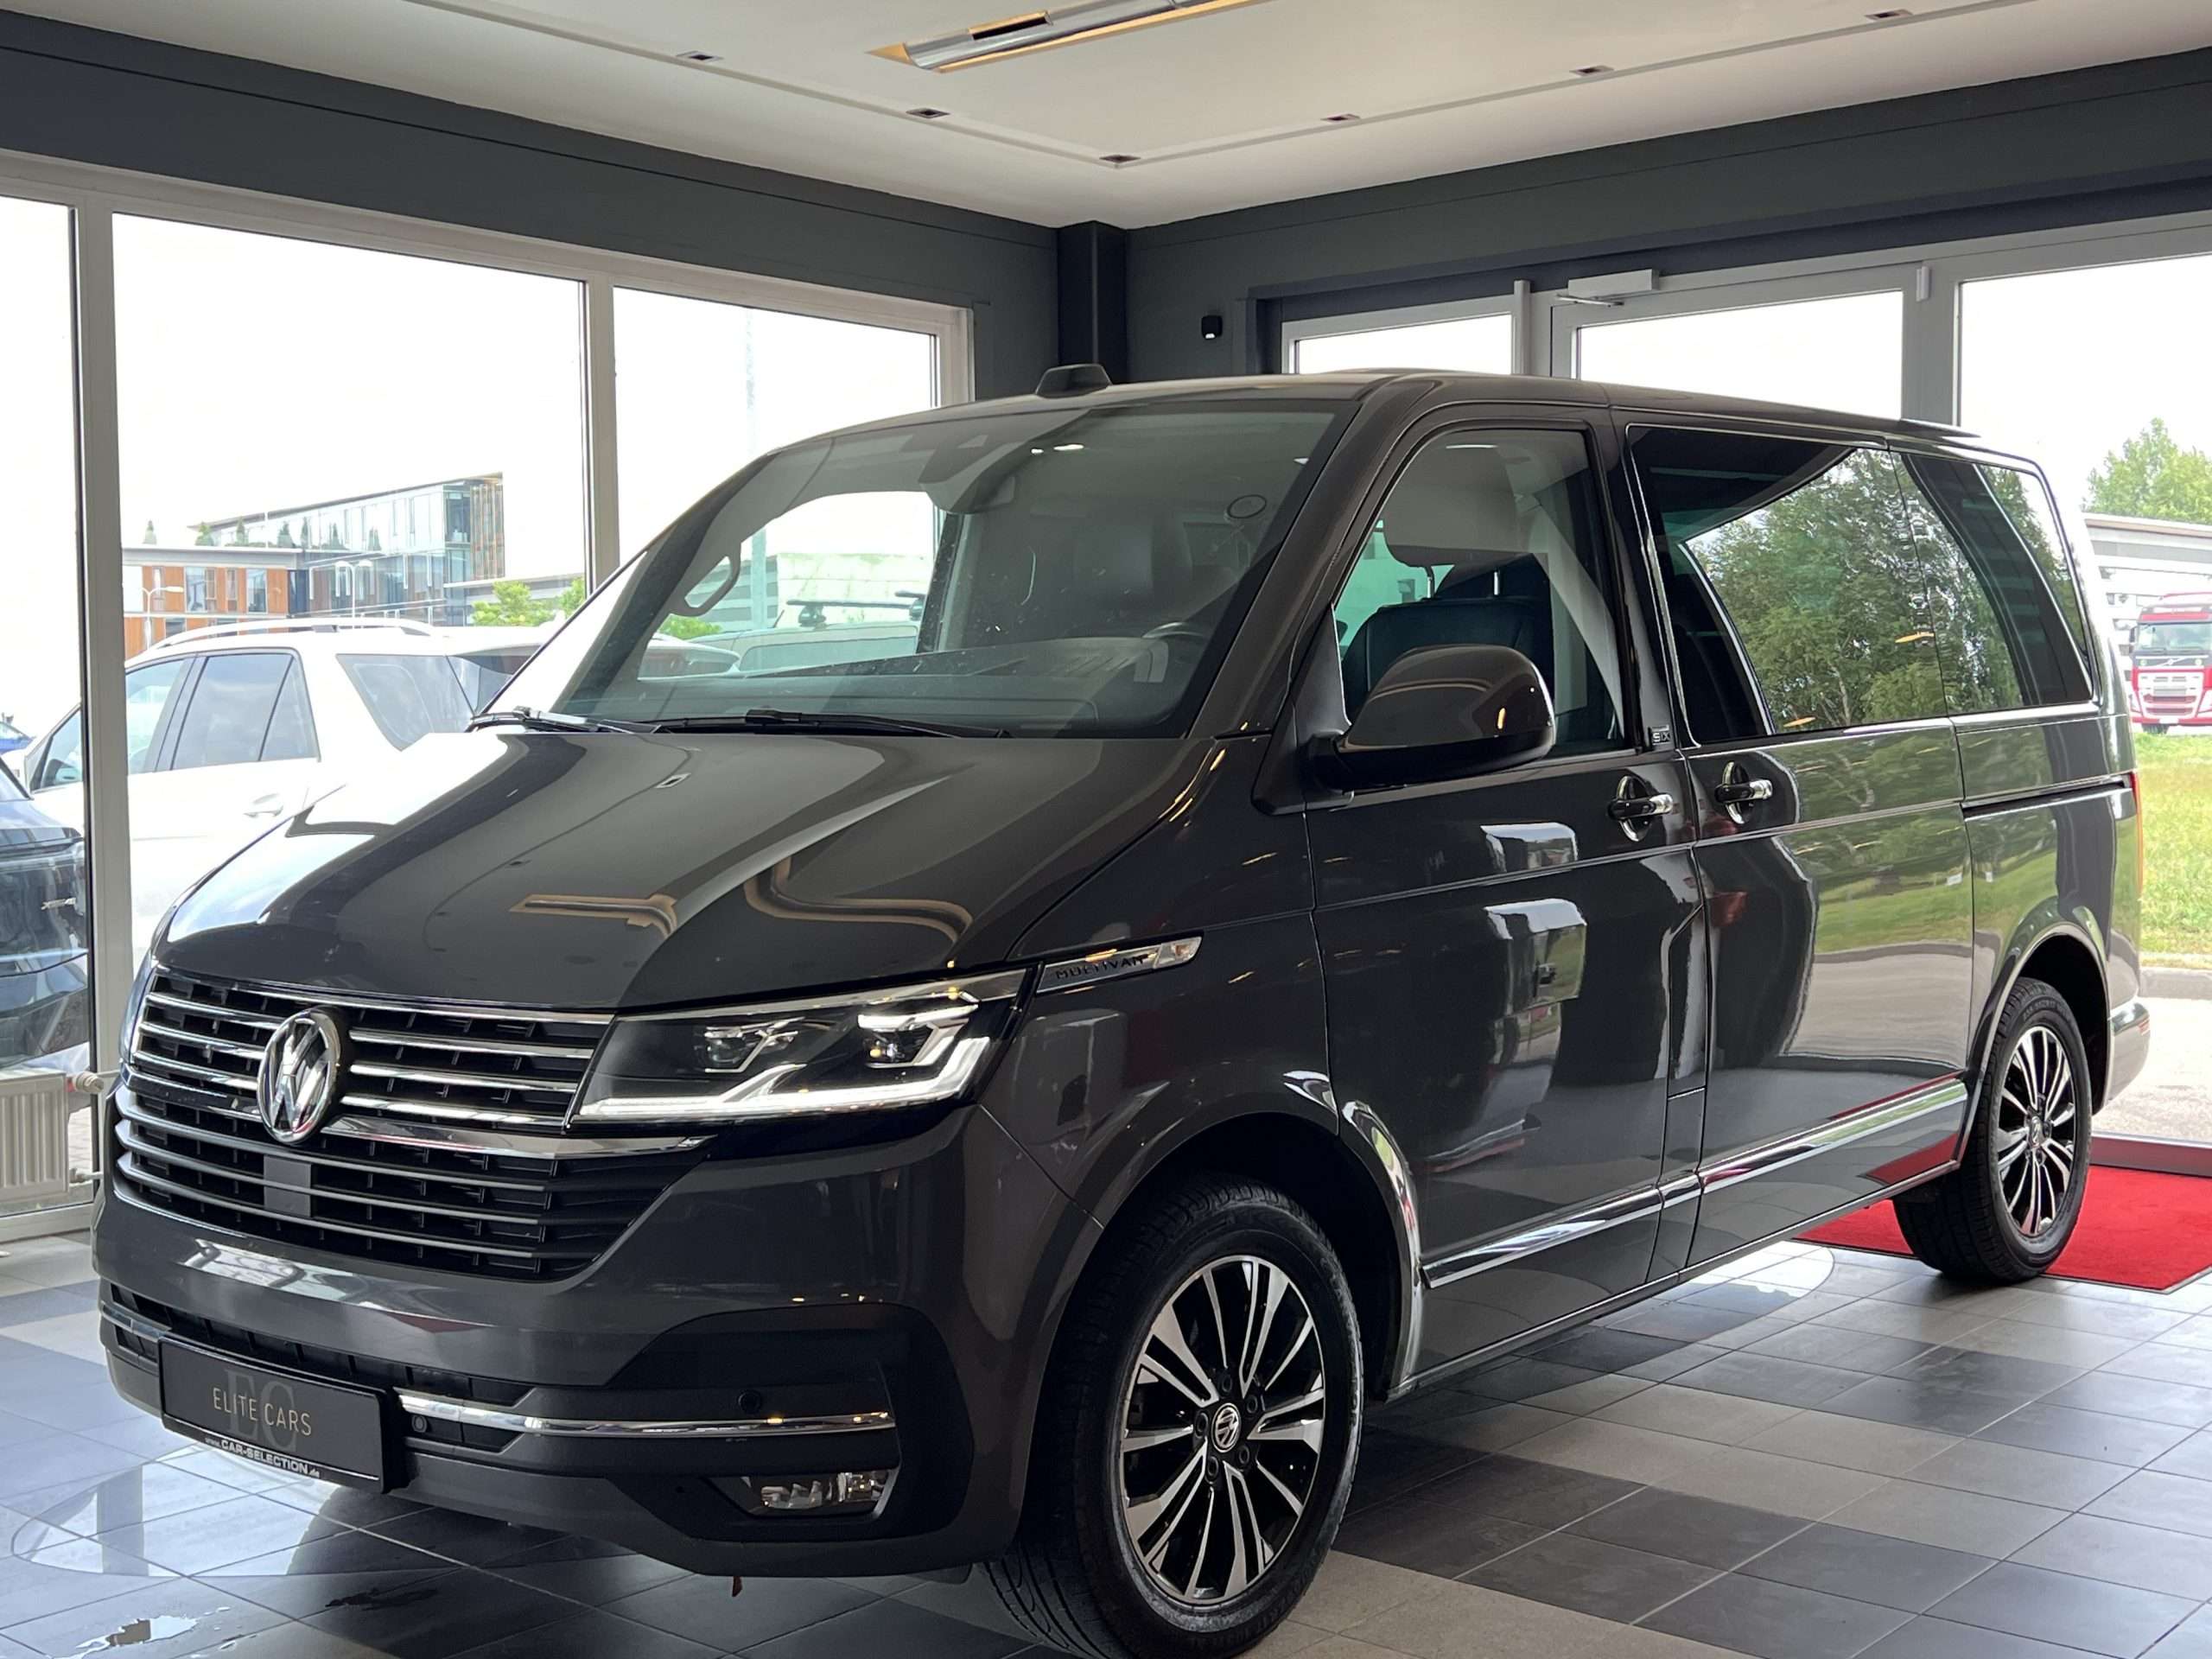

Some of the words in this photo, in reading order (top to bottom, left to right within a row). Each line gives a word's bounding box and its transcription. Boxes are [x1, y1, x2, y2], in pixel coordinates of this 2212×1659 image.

[1055, 955, 1144, 980] MULTIVAN
[213, 1387, 258, 1421] ELITE
[264, 1403, 312, 1436] CARS
